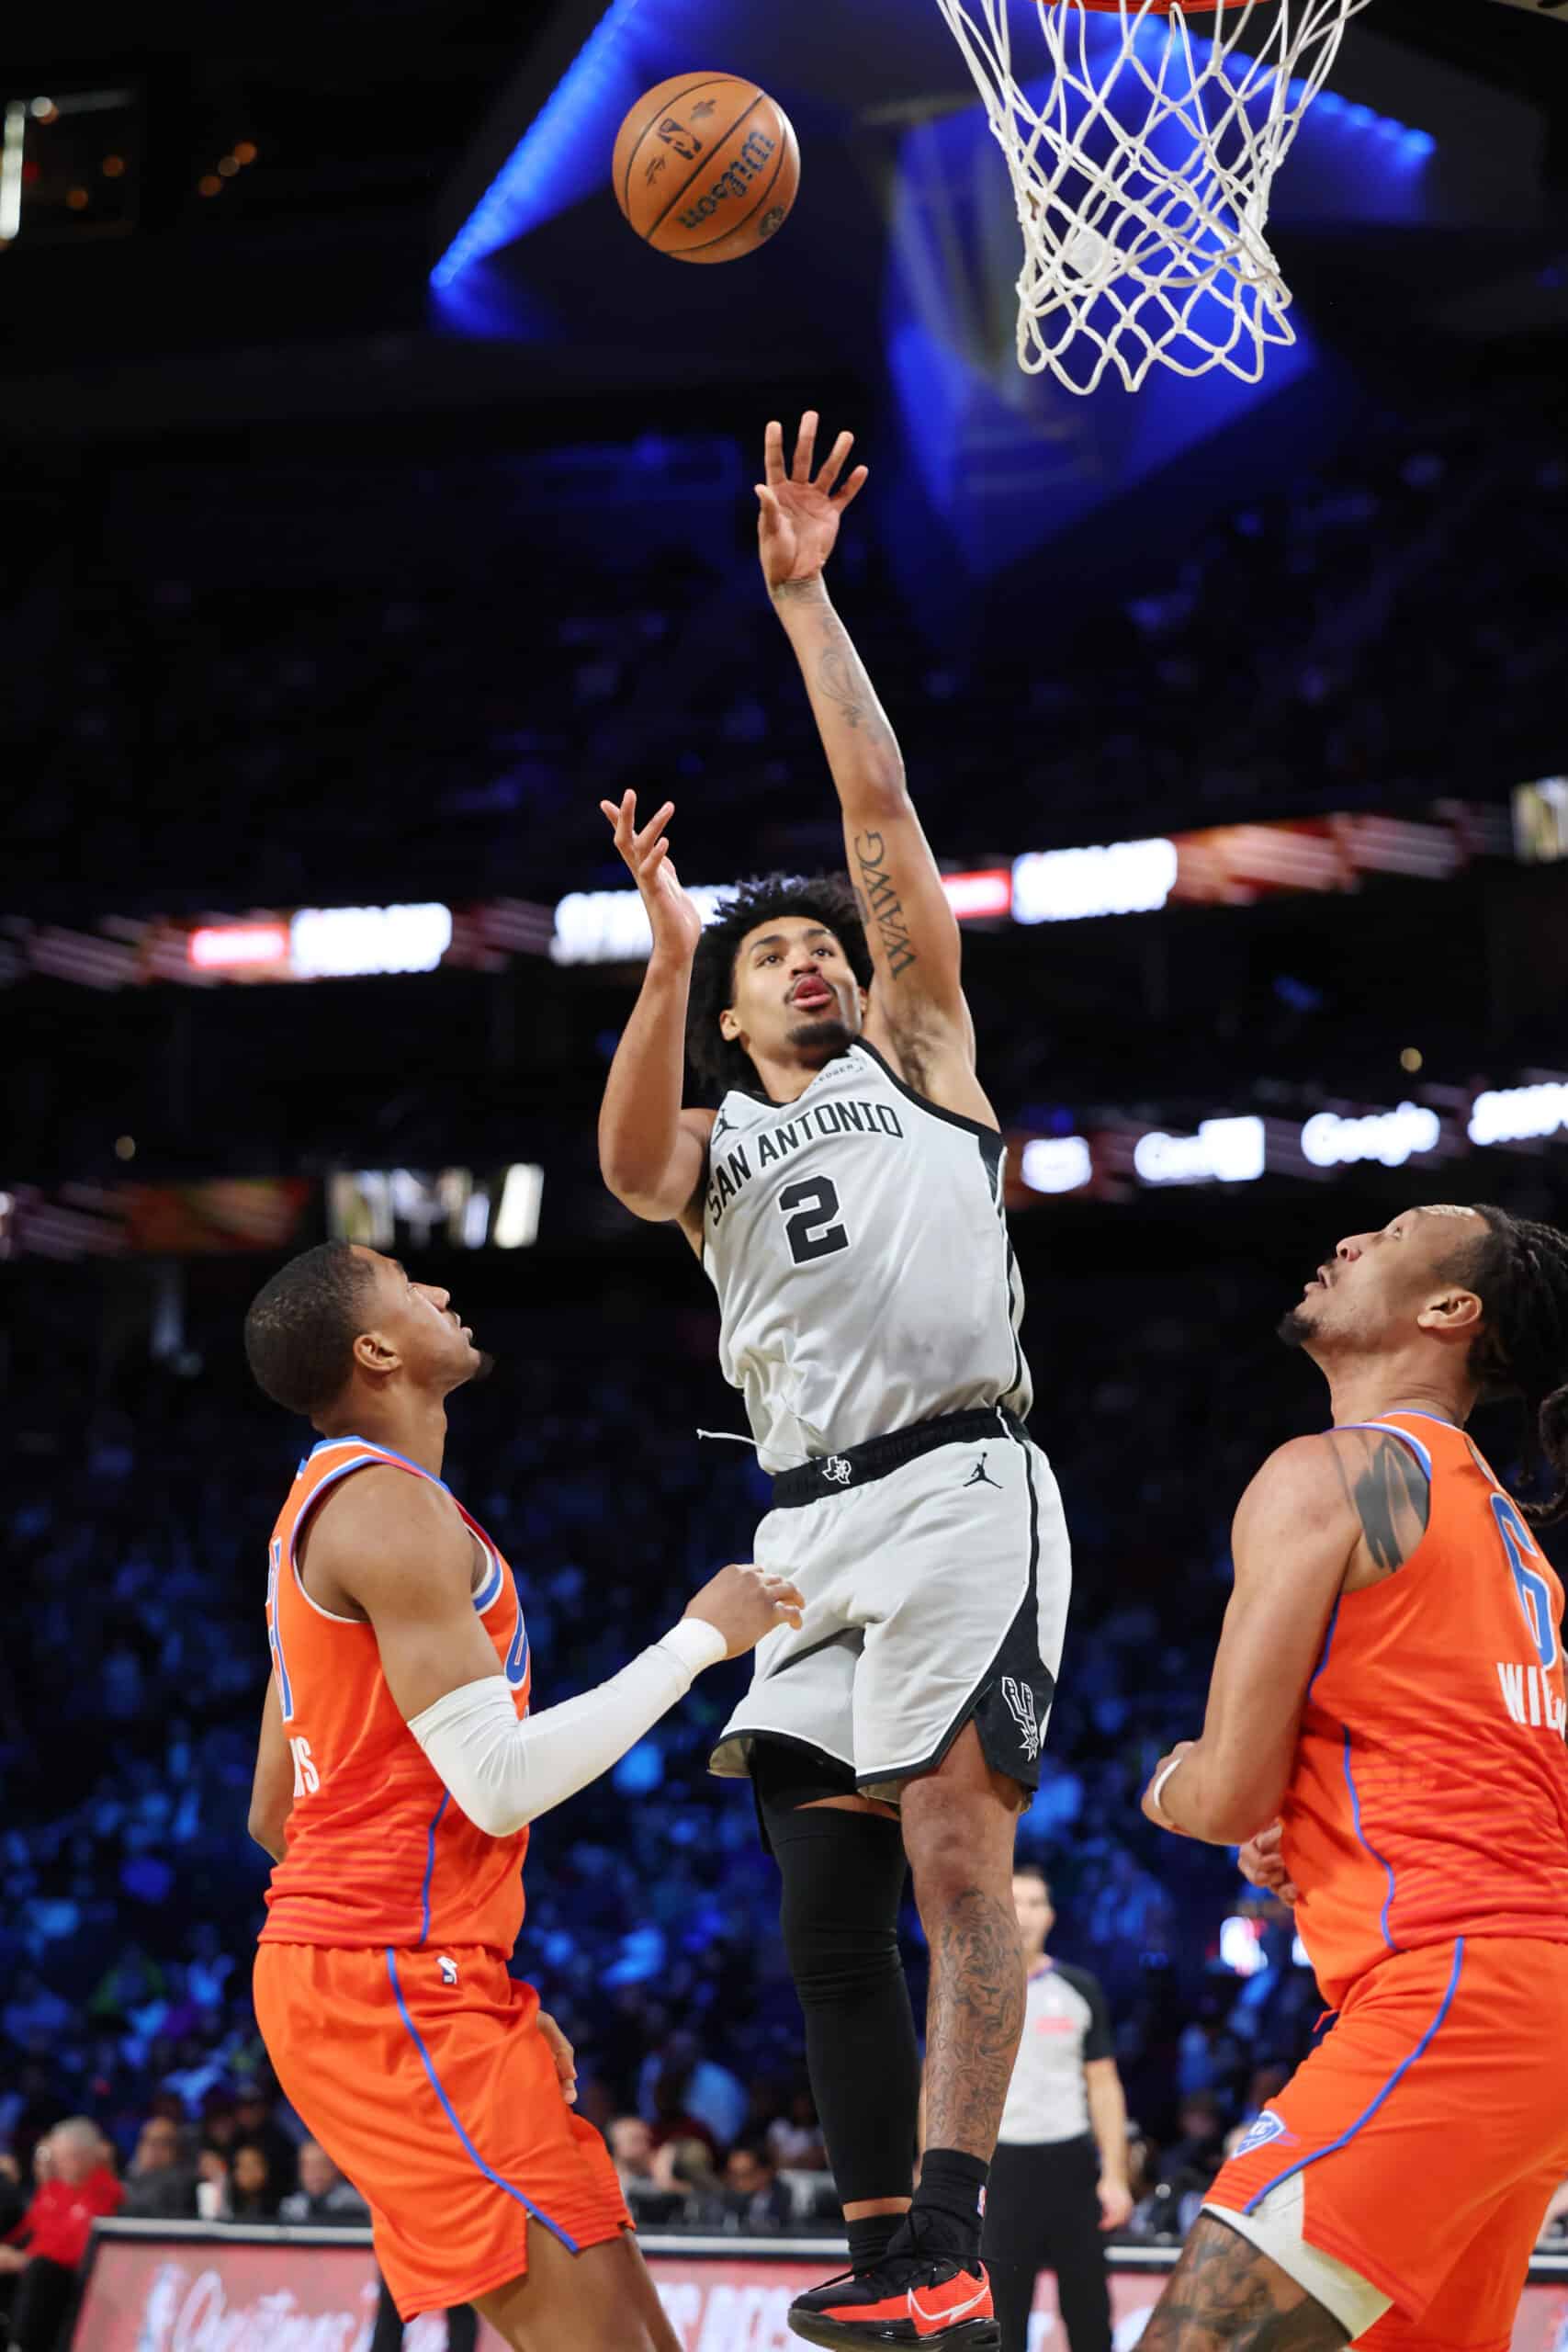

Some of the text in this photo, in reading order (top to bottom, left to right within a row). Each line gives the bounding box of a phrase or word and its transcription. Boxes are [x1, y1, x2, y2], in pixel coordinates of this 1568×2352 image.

[678, 131, 774, 229] Wilson
[707, 1102, 903, 1226] SAN ANTONIO
[779, 1175, 849, 1264] 2
[1490, 1492, 1556, 1670] 6
